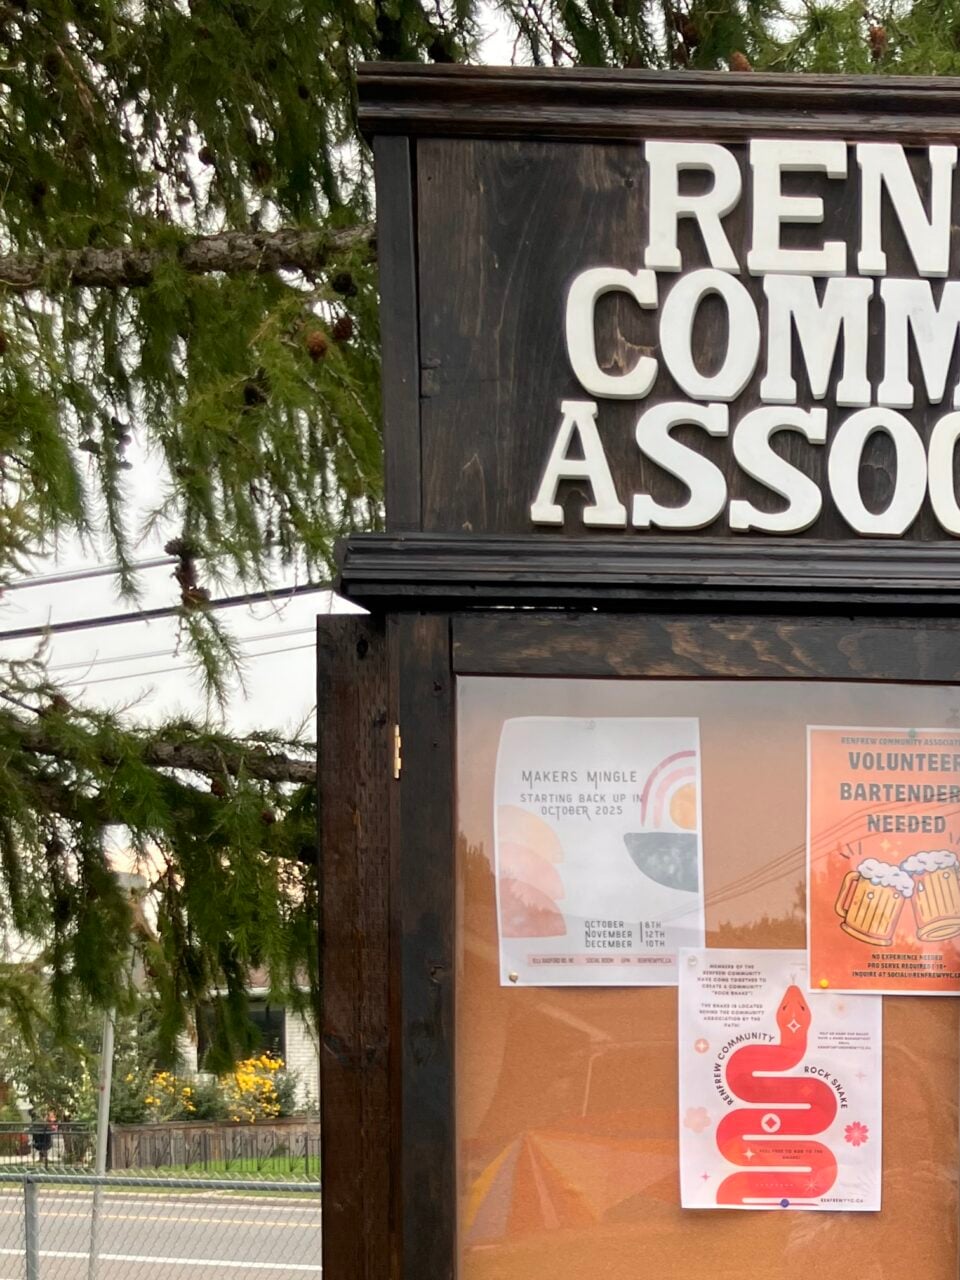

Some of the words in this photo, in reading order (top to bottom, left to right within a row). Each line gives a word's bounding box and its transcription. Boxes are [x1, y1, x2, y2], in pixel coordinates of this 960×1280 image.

[841, 737, 877, 746] RENFREW
[879, 737, 921, 747] COMMUNITY
[521, 771, 578, 790] MAKERS
[587, 771, 638, 790] MINGLE
[520, 793, 573, 803] STARTING
[579, 793, 606, 803] BACK
[612, 794, 626, 803] UP
[632, 794, 643, 803] IN
[541, 805, 591, 821] OCTOBER
[595, 806, 623, 815] 2025
[867, 814, 947, 834] NEEDED
[585, 920, 624, 931] OCTOBER
[585, 931, 632, 940] NOVEMBER
[645, 931, 665, 940] 12TH
[586, 940, 632, 948] DECEMBER
[645, 940, 665, 948] 10TH
[882, 953, 918, 961] EXPERIENCE
[852, 970, 877, 978] INQUIRE
[717, 1032, 776, 1060] COMMUNITY
[713, 1062, 735, 1106] RENFREW
[804, 1065, 832, 1081] ROCK
[831, 1078, 849, 1109] SNAKE
